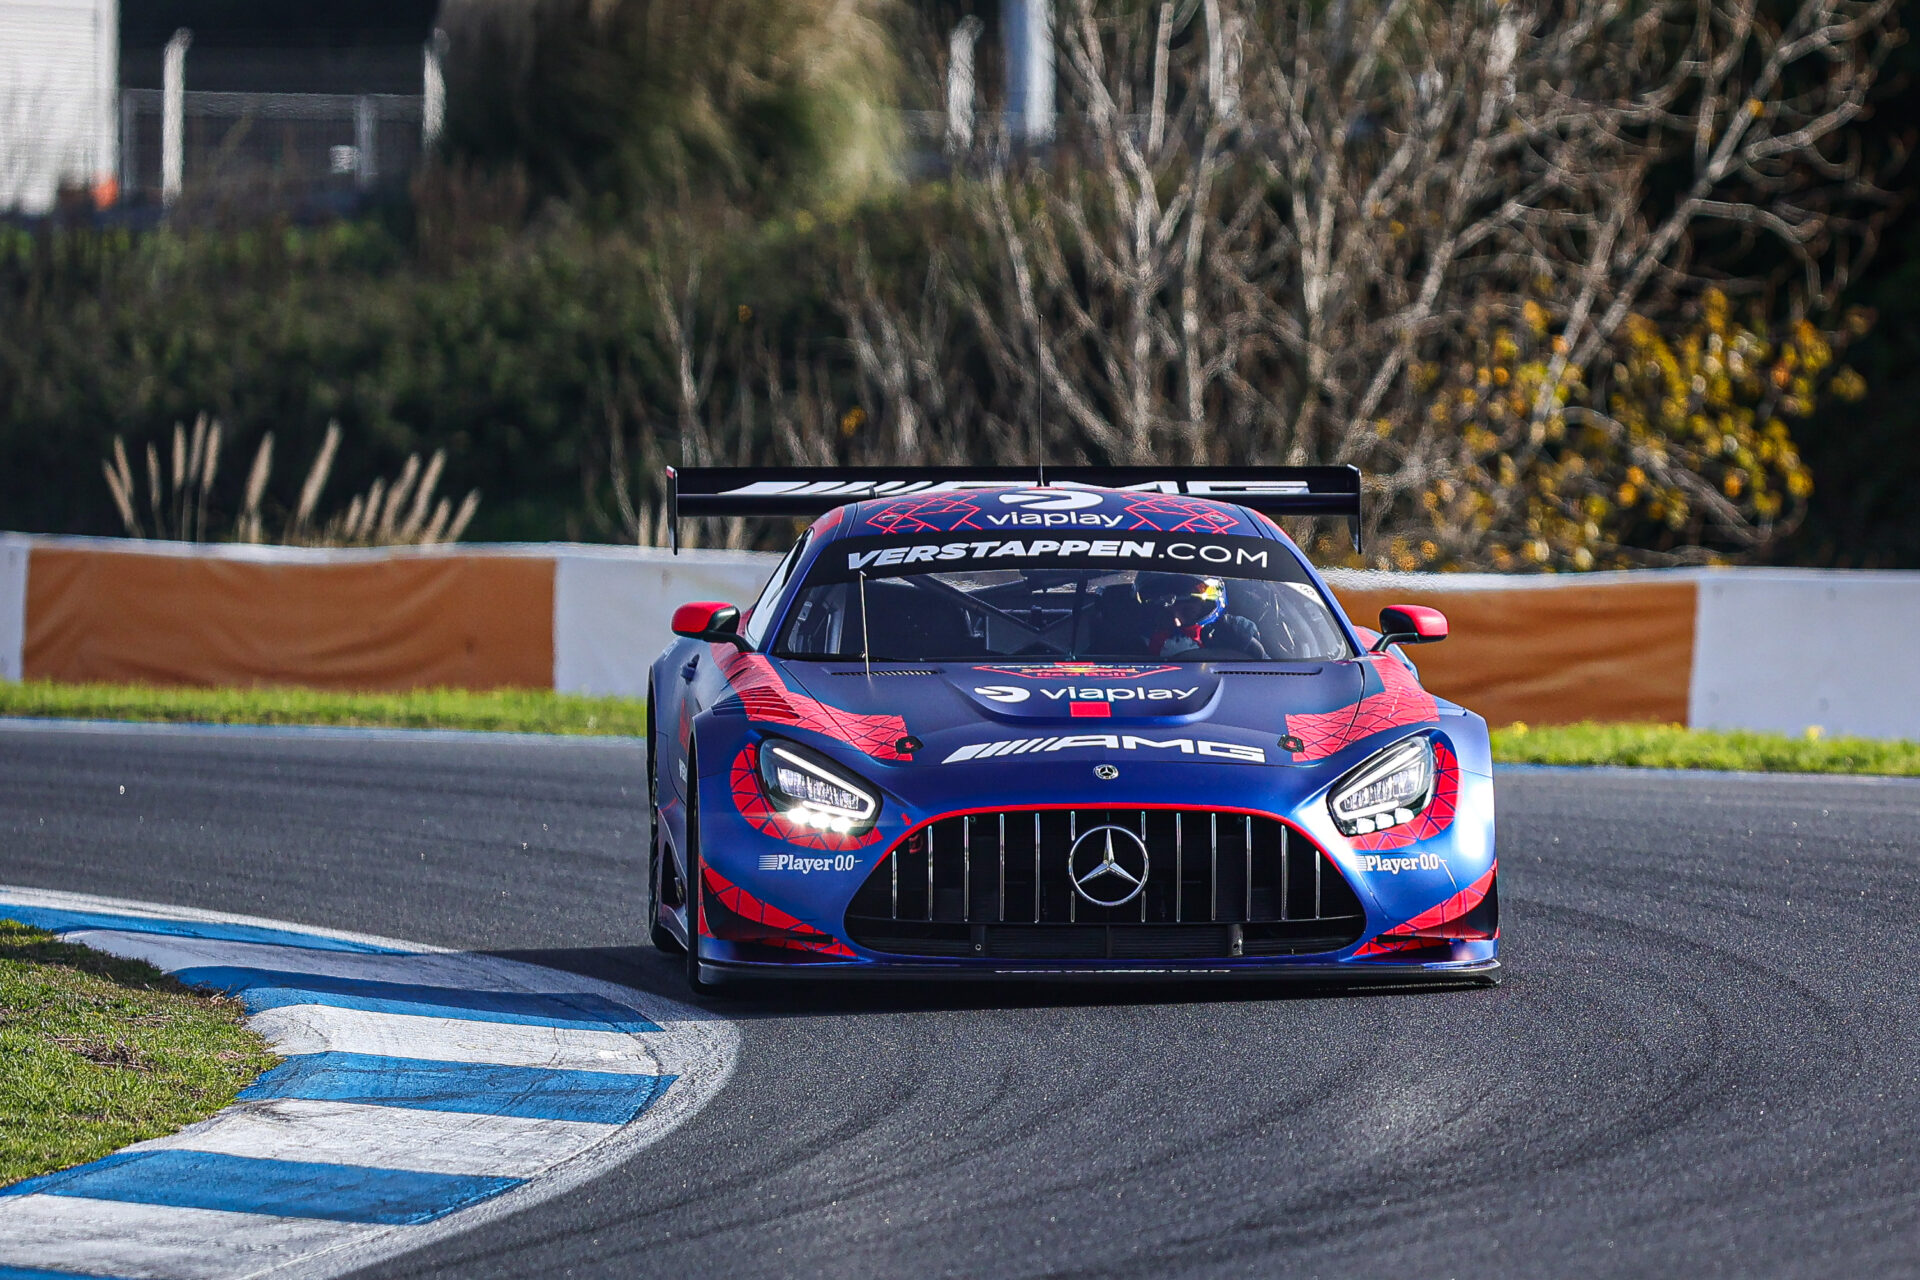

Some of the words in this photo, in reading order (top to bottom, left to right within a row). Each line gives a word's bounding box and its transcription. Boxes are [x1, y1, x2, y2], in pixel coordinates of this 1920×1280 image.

[986, 508, 1124, 529] viaplay
[848, 540, 1268, 569] VERSTAPPEN.COM
[1040, 686, 1199, 702] viaplay
[1045, 735, 1265, 763] AMG
[777, 854, 833, 874] Player
[1365, 855, 1419, 875] Player
